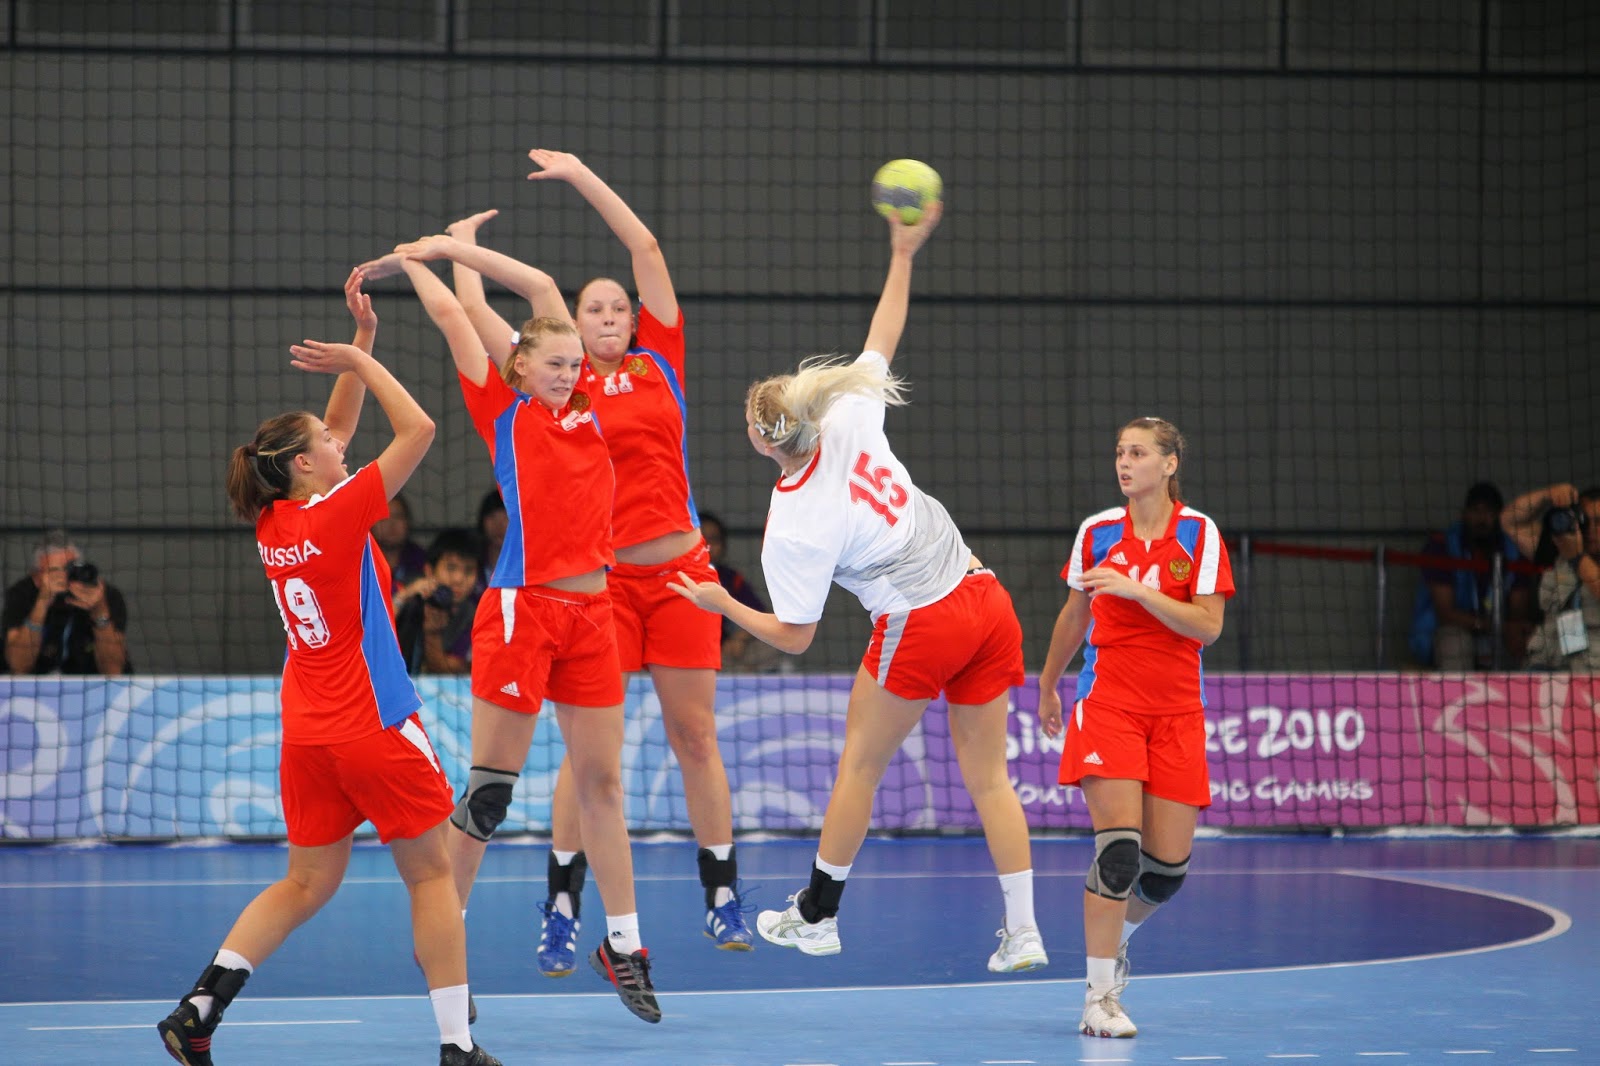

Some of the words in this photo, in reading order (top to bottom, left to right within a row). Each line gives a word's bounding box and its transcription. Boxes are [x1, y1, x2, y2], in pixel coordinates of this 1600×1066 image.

[848, 450, 909, 528] 15
[1127, 564, 1161, 591] 14
[1248, 706, 1365, 758] 2010
[1254, 777, 1374, 807] GAMES
